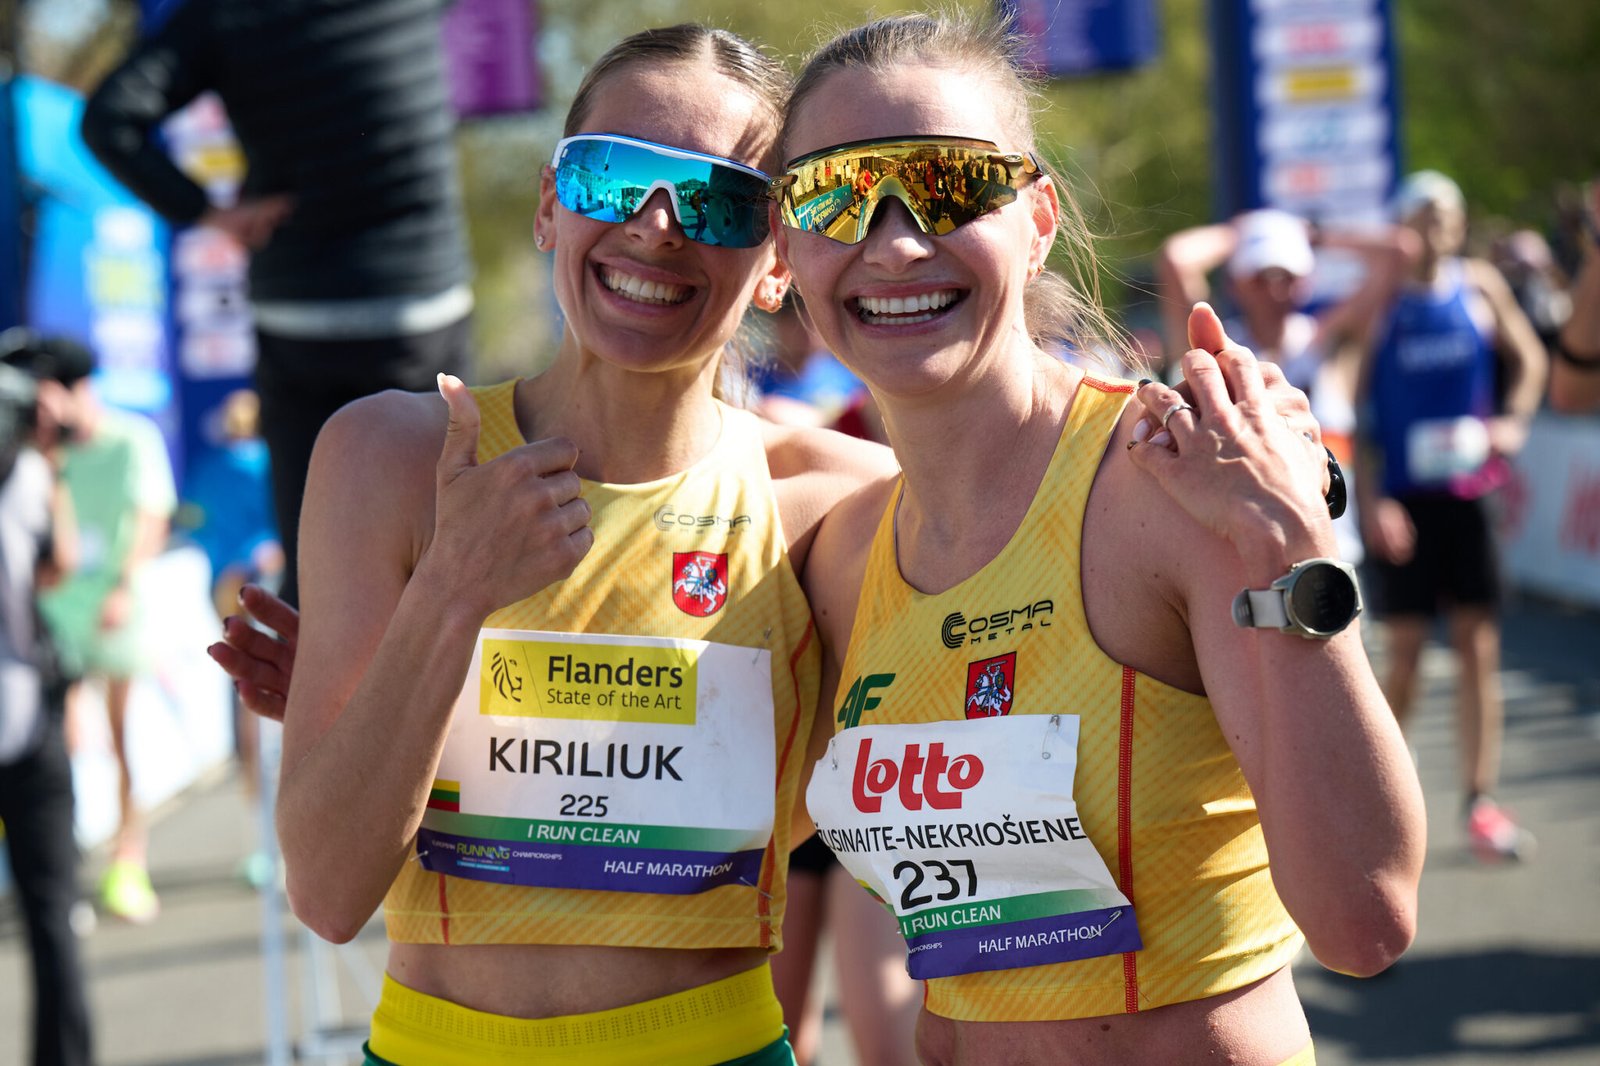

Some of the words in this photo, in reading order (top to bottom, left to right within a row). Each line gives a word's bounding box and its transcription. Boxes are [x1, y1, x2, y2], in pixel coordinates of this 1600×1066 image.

[941, 600, 1054, 649] COSMA
[970, 620, 1052, 645] METAL
[547, 654, 683, 688] Flanders
[547, 688, 591, 705] State
[597, 690, 616, 707] of
[622, 691, 650, 708] the
[654, 694, 682, 710] Art
[489, 736, 684, 782] KIRILIUK
[851, 738, 985, 814] lotto
[559, 794, 609, 818] 225
[527, 824, 534, 839] I
[537, 824, 577, 841] RUN
[580, 827, 641, 844] CLEAN
[456, 842, 511, 860] RUNNING
[512, 850, 563, 861] CHAMPIONSHIPS
[603, 860, 645, 875] HALF
[646, 862, 733, 878] MARATHON
[893, 859, 978, 910] 237
[903, 921, 909, 936] I
[912, 911, 949, 934] RUN
[951, 904, 1002, 926] CLEAN
[979, 936, 1013, 954] HALF
[1015, 924, 1102, 949] MARATHON
